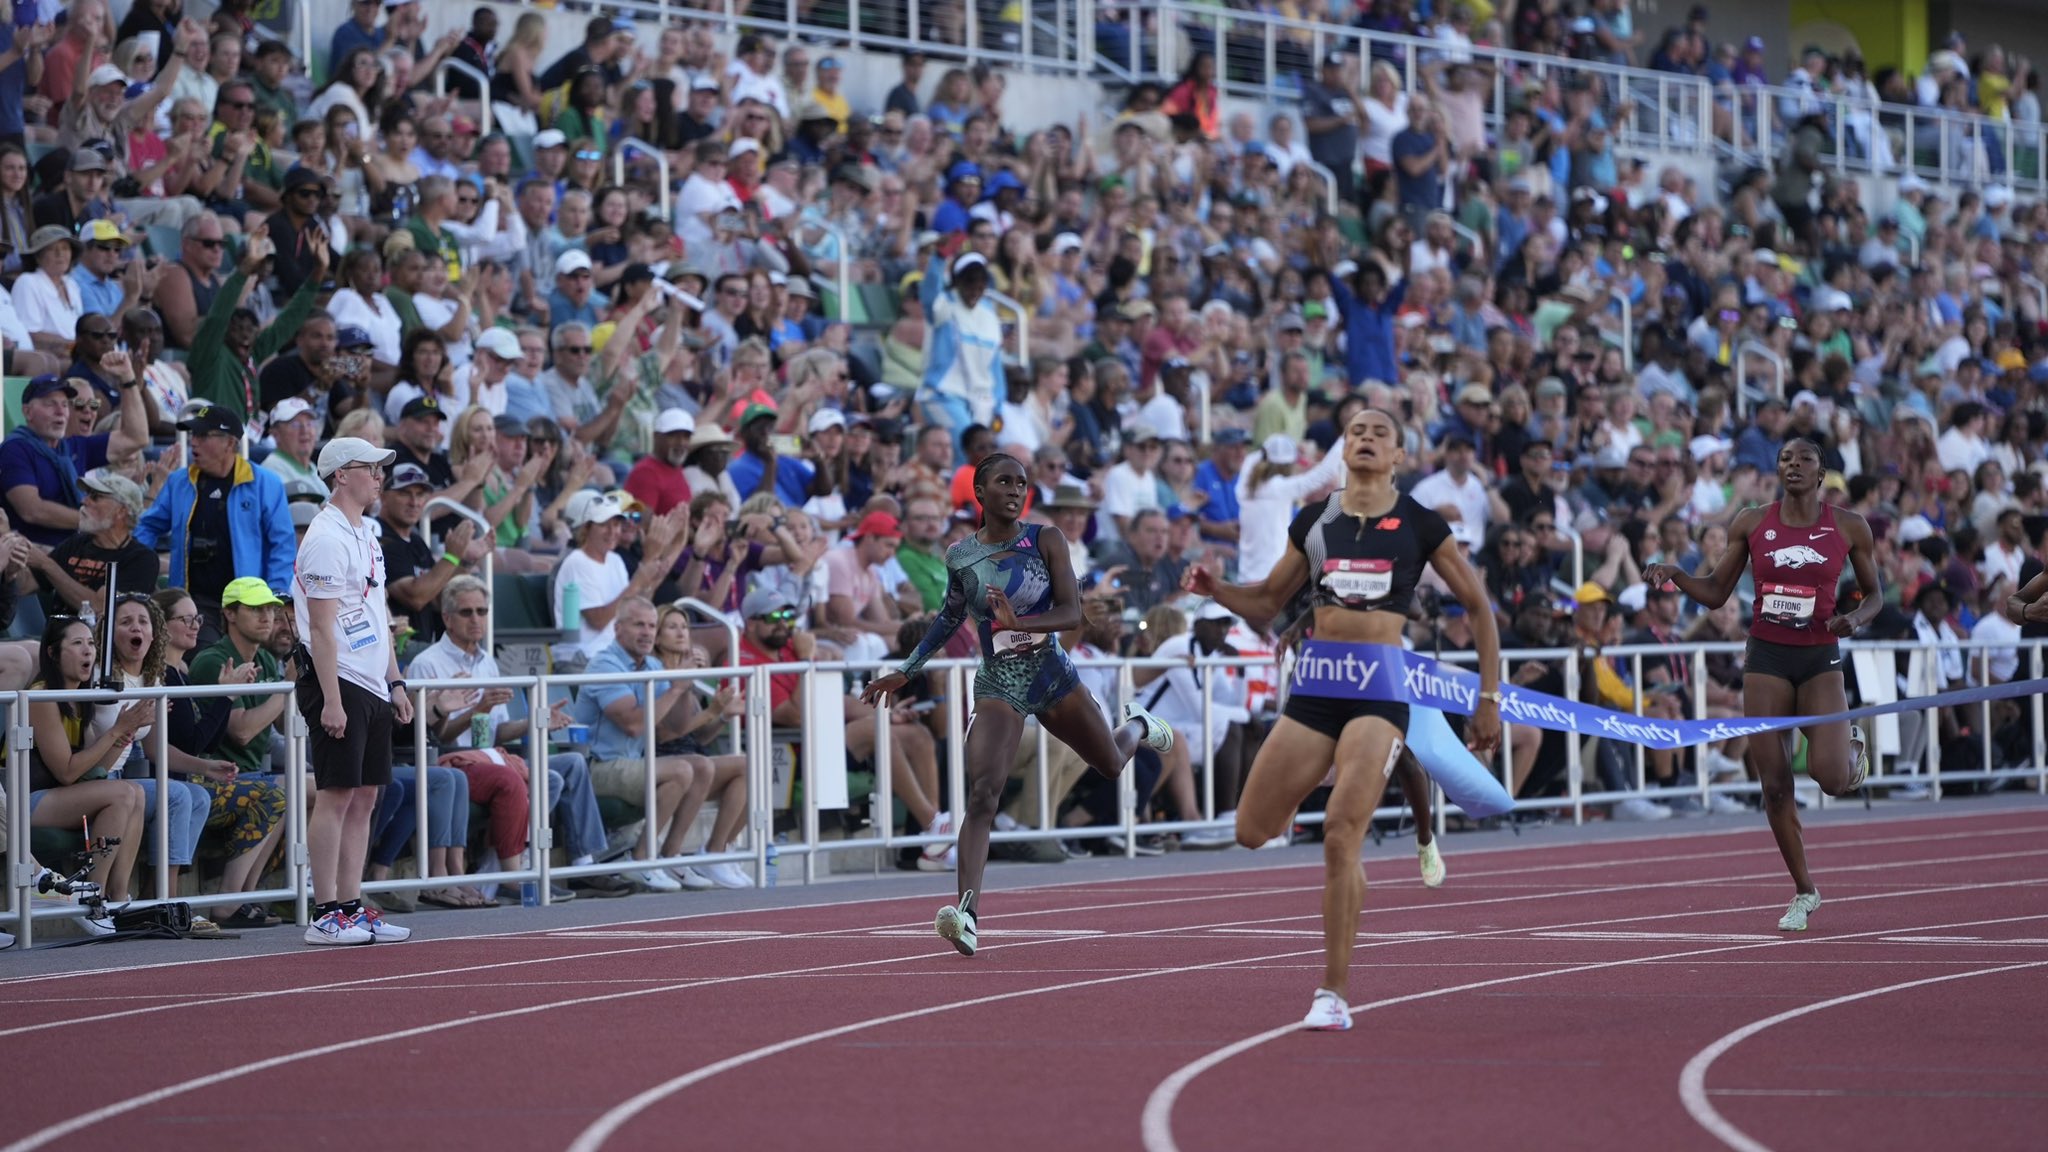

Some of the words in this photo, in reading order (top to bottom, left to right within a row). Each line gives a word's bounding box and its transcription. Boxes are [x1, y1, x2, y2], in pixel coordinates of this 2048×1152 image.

[1772, 599, 1802, 612] EFFIONG
[1010, 633, 1032, 643] DIGGS
[1403, 662, 1476, 711] xfinity
[1500, 691, 1577, 729] xfinity
[1596, 714, 1683, 745] xfinity
